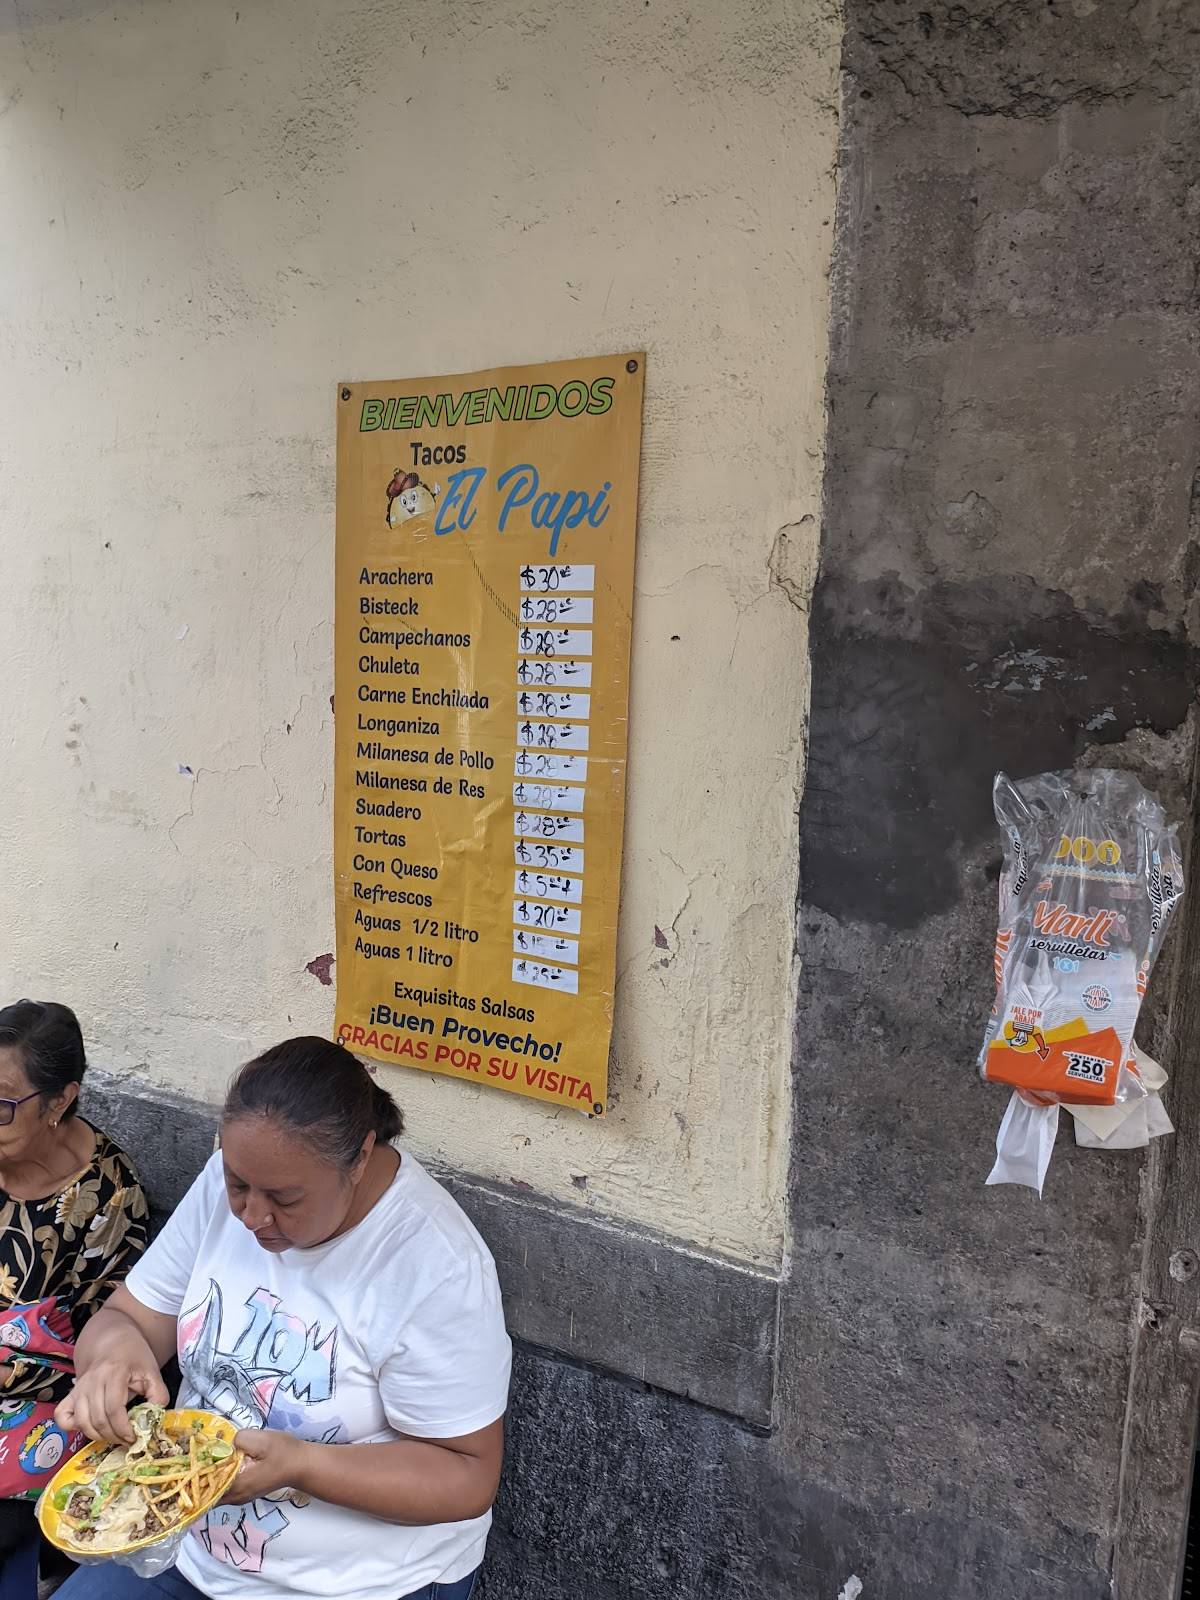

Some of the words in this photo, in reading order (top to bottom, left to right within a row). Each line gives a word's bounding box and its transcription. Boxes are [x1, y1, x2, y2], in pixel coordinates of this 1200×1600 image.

[360, 377, 615, 432] BIENVENIDOS
[410, 442, 466, 465] Tacos
[434, 467, 487, 535] El
[497, 463, 612, 557] Papi
[359, 567, 433, 585] Arachera
[359, 597, 419, 615] Bisteck
[359, 627, 471, 649] Campechanos
[358, 656, 420, 675] Chuleta
[357, 685, 406, 704] Carne
[412, 688, 489, 709] Enchilada
[357, 714, 440, 737] Longaniza
[357, 743, 429, 764] Milanesa
[435, 747, 454, 765] de
[460, 750, 494, 770] Pollo
[355, 771, 427, 793] Milanesa
[433, 777, 453, 795] de
[459, 780, 485, 798] Res
[356, 799, 421, 820] Suadero
[354, 826, 406, 846] Tortas
[353, 855, 385, 873] Con
[391, 858, 438, 880] Queso
[353, 882, 433, 908] Refrescos
[355, 910, 401, 932] Aguas
[413, 918, 439, 937] 1/2
[445, 922, 479, 942] litro
[355, 937, 400, 960] Aguas
[406, 946, 413, 961] 1
[418, 946, 453, 967] litro
[1030, 939, 1108, 961] servilletas
[394, 982, 476, 1011] Exquisitas
[481, 997, 535, 1022] Salsas
[1010, 1005, 1027, 1015] JALE
[1028, 1009, 1042, 1018] POR
[1014, 1014, 1035, 1024] ABAJO
[369, 1005, 434, 1035] ¡Buen
[442, 1017, 562, 1063] Provecho!
[338, 1023, 429, 1060] GRACIAS
[435, 1045, 481, 1072] POR
[486, 1057, 518, 1082] SU
[525, 1065, 593, 1104] VISITA
[1070, 1058, 1103, 1076] 250
[1067, 1070, 1103, 1082] SERVILLETAS
